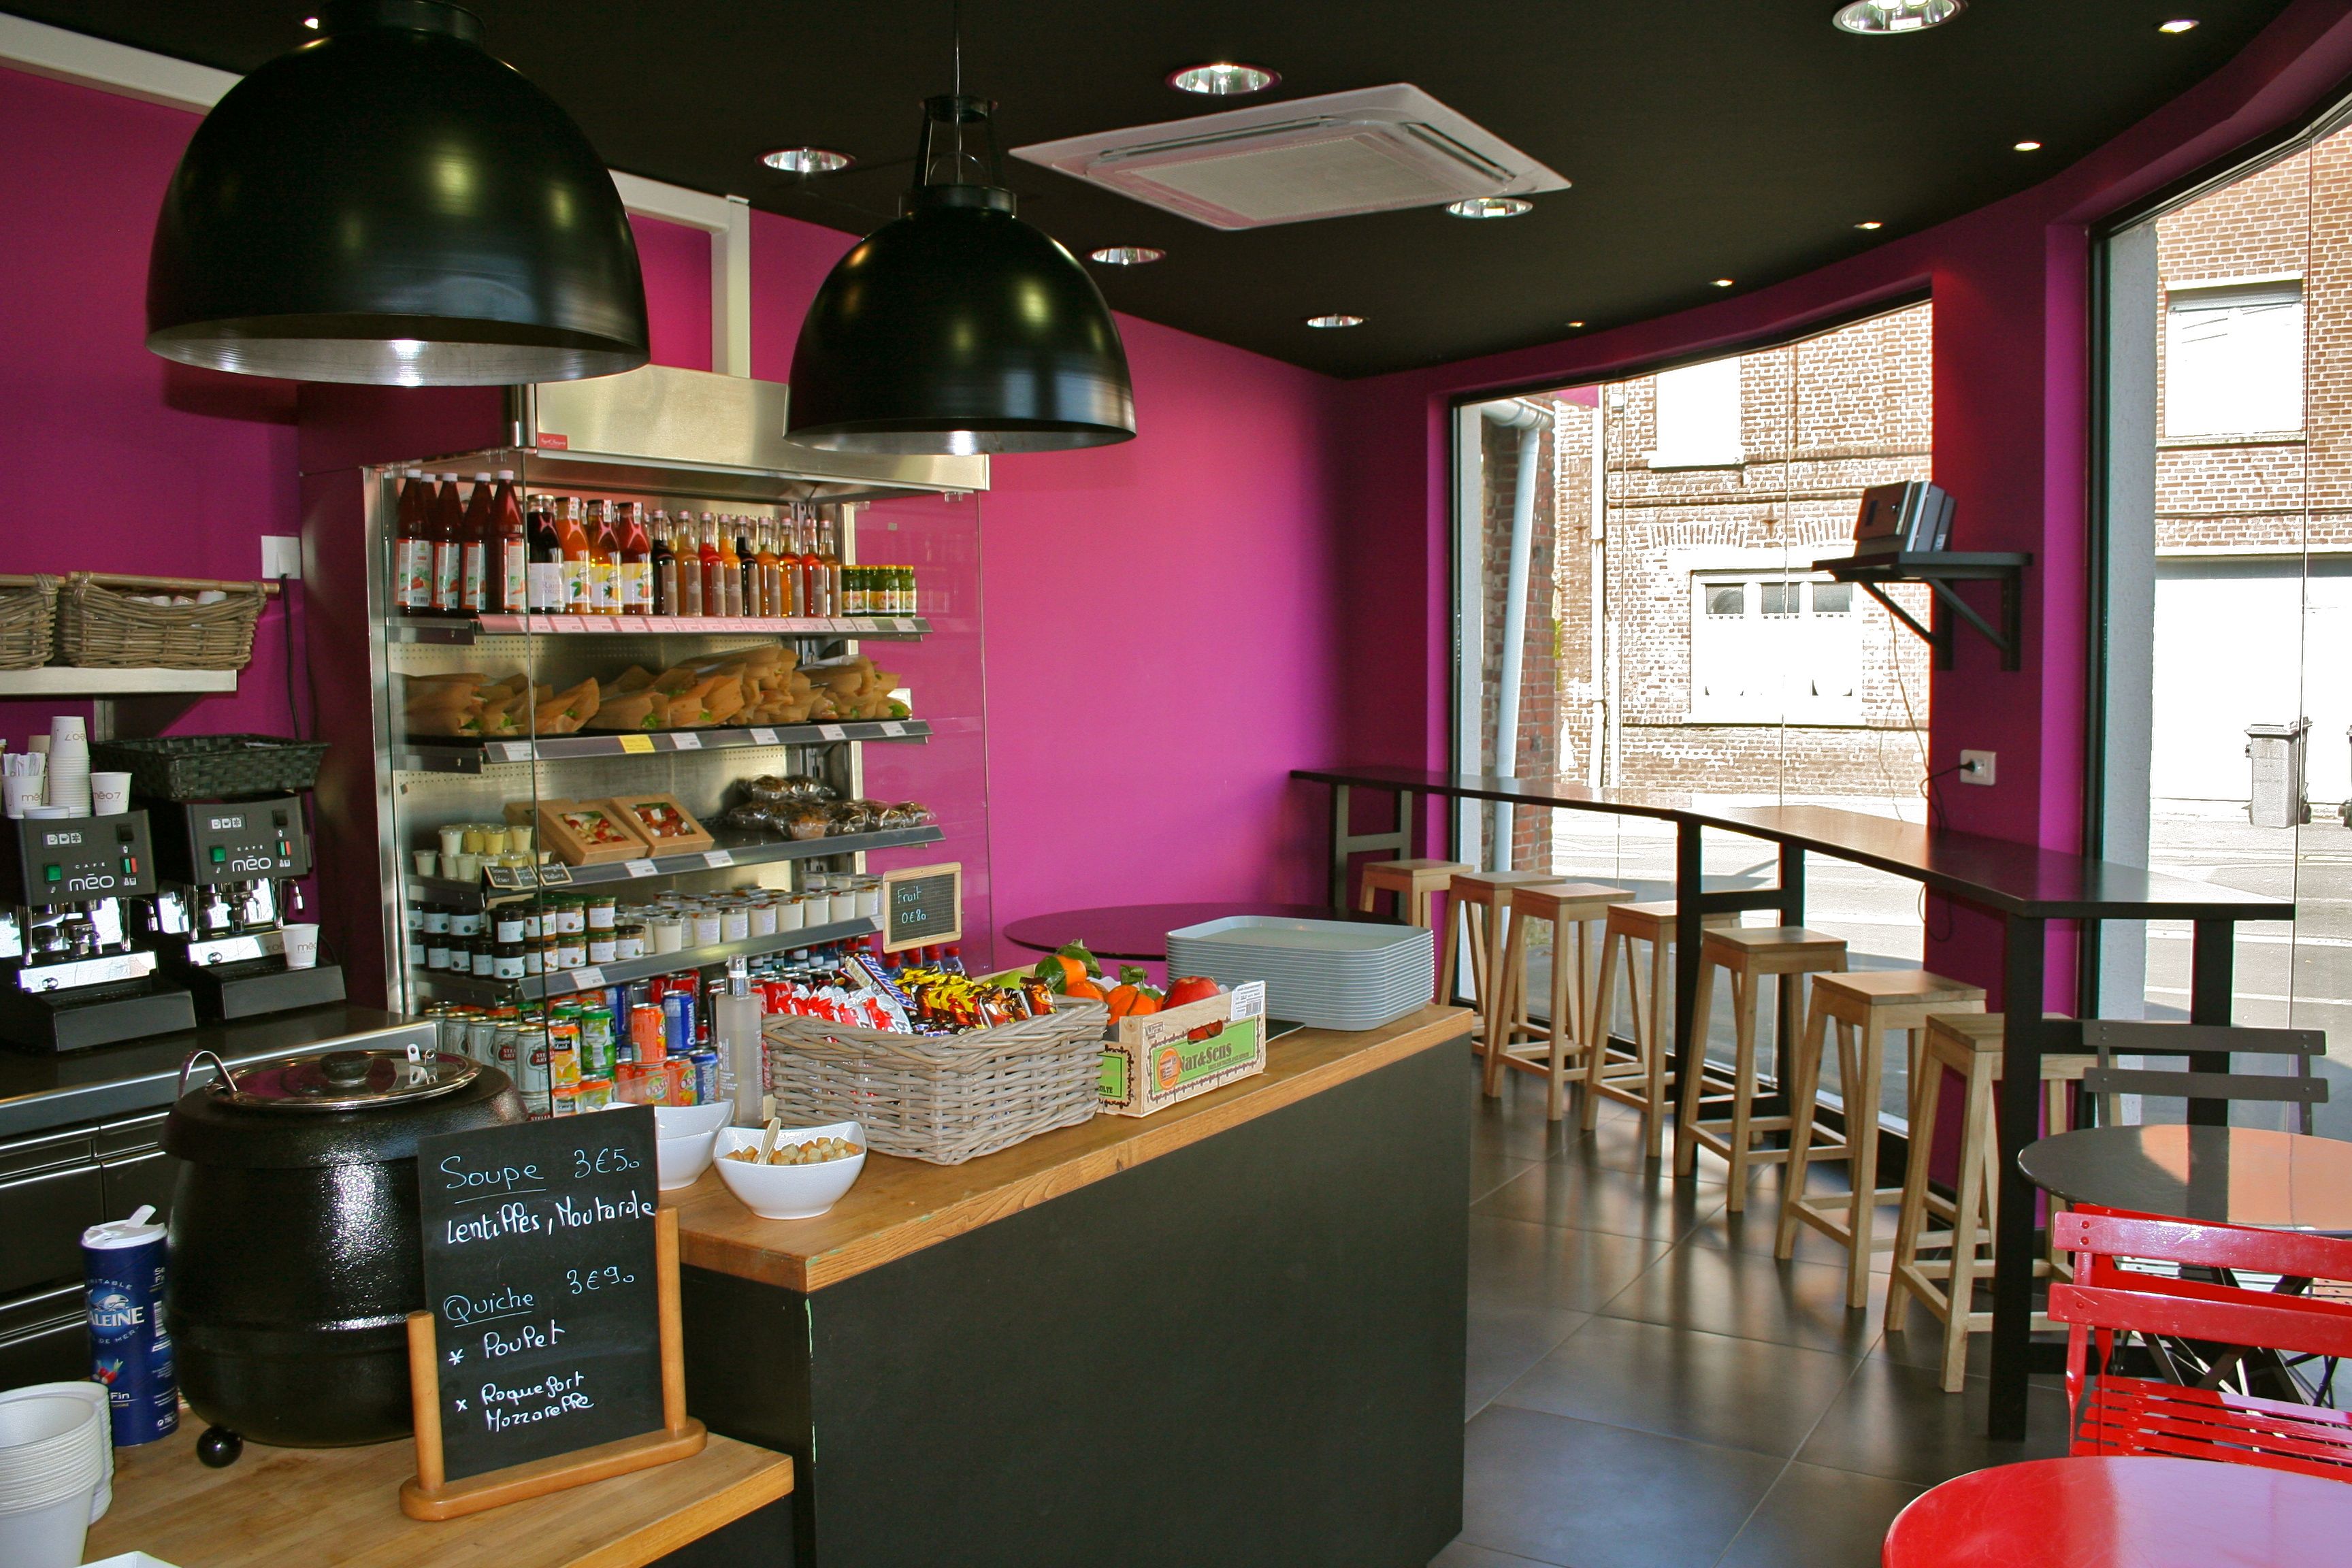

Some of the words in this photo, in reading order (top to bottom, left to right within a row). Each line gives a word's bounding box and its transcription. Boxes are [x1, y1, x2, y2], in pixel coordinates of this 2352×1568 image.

[897, 885, 922, 904] Fruit
[901, 909, 926, 924] 0€80
[441, 1156, 544, 1190] Soupe
[574, 1147, 640, 1179] 3€50
[566, 1266, 634, 1294] 3€90
[88, 1306, 145, 1327] ALEINE
[443, 1287, 534, 1322] Quiche
[483, 1319, 566, 1359] Poulet
[111, 1392, 130, 1400] Fin
[480, 1371, 585, 1406] Roquefort
